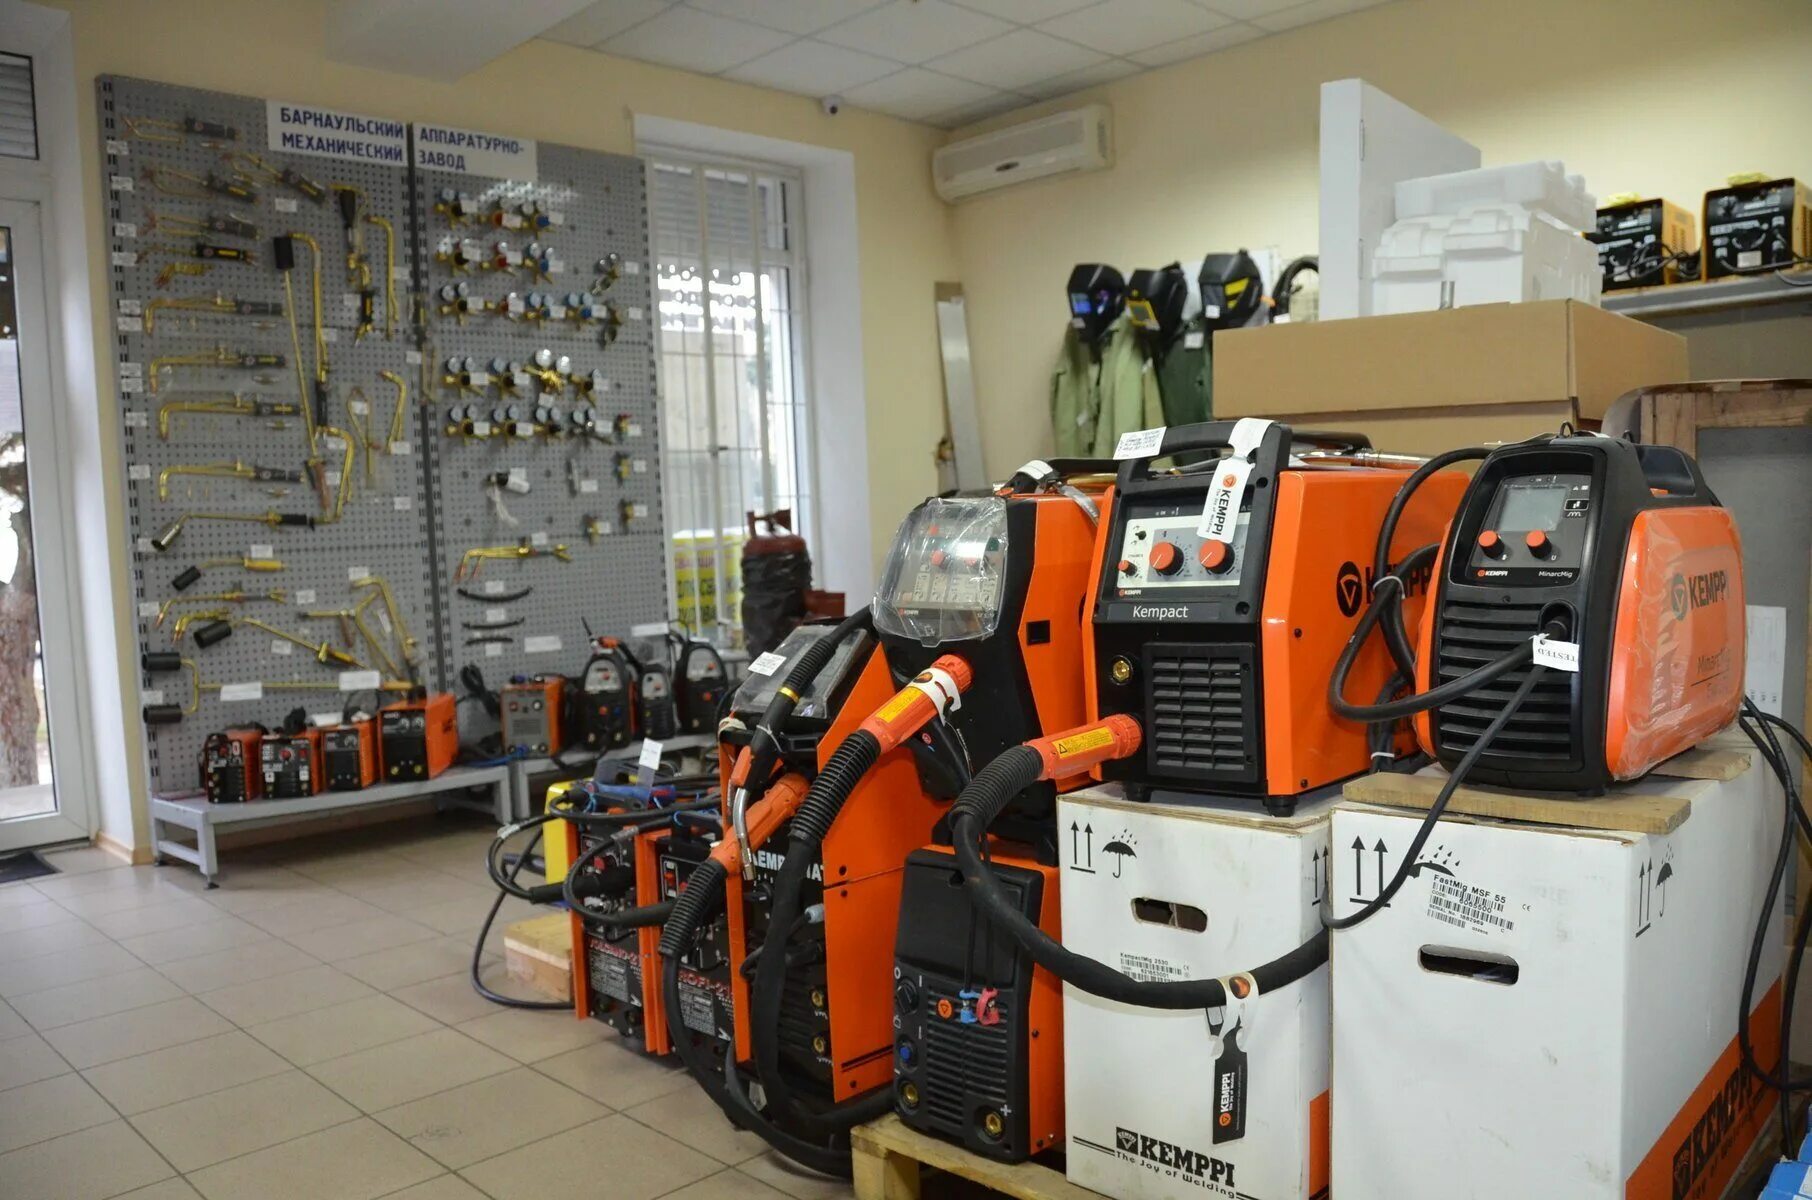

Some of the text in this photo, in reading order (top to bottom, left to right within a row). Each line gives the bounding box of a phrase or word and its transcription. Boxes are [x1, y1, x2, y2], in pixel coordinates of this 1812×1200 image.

[281, 107, 404, 139] БАРНАУЛЬСКИЙ
[281, 132, 403, 161] МЕХАНИЧЕСКИЙ
[419, 127, 524, 154] АППАРАТУРНО-
[419, 150, 466, 171] ЗАВОД
[1212, 489, 1232, 536] KEMPPI
[1538, 570, 1573, 579] MinarcMig
[1132, 605, 1189, 620] Kempact
[1434, 874, 1506, 904] FastMig MSF 55
[1220, 1072, 1231, 1113] KEMPPI
[1117, 1151, 1235, 1199] The Joy of Welding
[1140, 1134, 1235, 1188] KEMPPI
